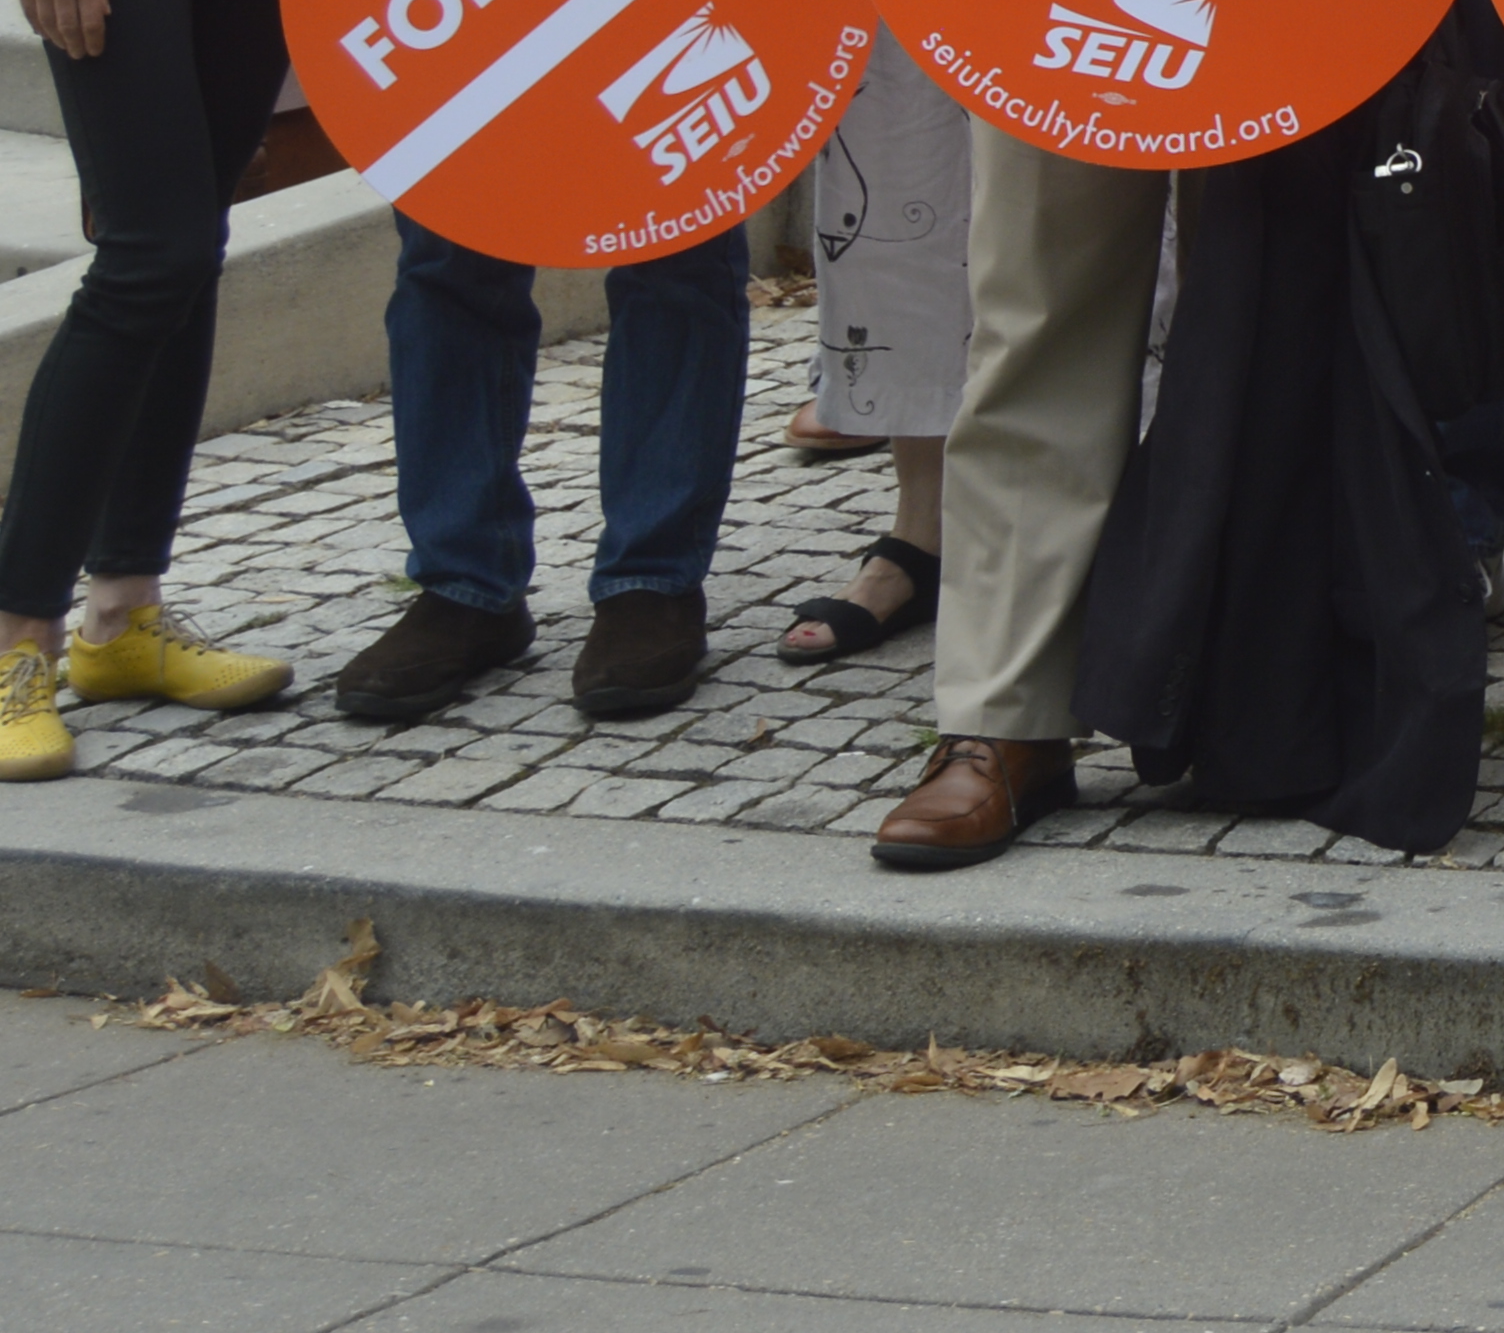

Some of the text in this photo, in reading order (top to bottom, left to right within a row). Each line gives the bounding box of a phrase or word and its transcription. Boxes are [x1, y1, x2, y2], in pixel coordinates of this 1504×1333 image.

[648, 57, 772, 185] SEIU
[921, 25, 1300, 153] seiufacultyforward.org
[1033, 26, 1205, 89] SEIU
[584, 25, 869, 255] seiufacultyforward.org
